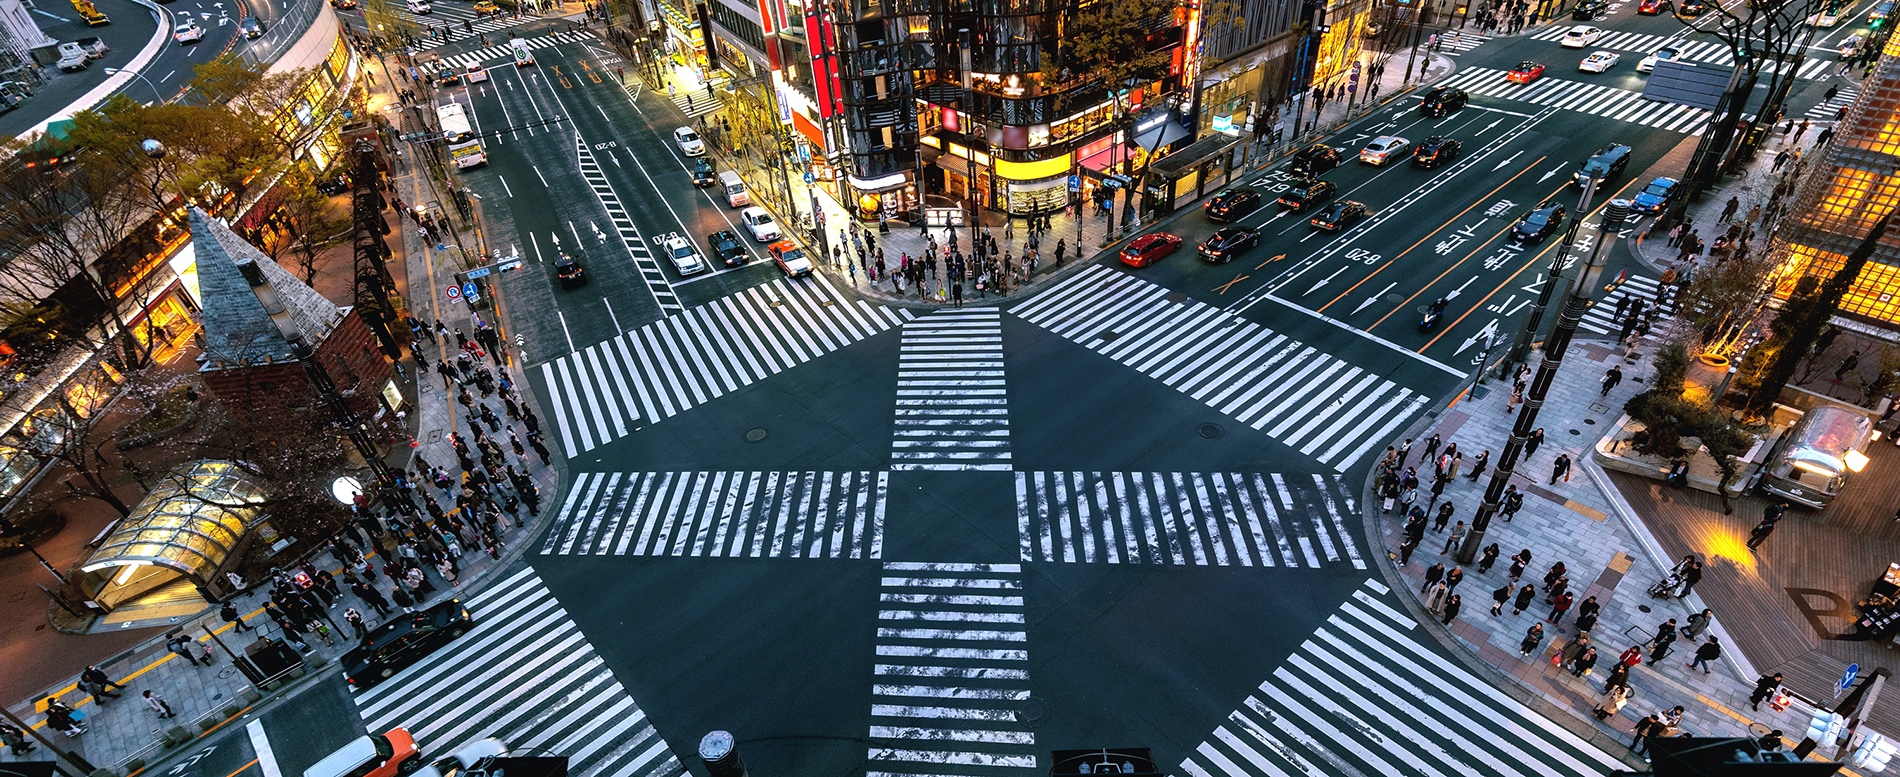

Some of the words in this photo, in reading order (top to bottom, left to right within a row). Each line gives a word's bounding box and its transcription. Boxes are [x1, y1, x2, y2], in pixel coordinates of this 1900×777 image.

[1335, 122, 1397, 152] バス
[595, 141, 616, 150] 8-20
[1249, 178, 1290, 193] 17-19
[652, 231, 678, 246] 8-20
[1344, 248, 1382, 265] 8-20
[1484, 240, 1525, 272] 地下
